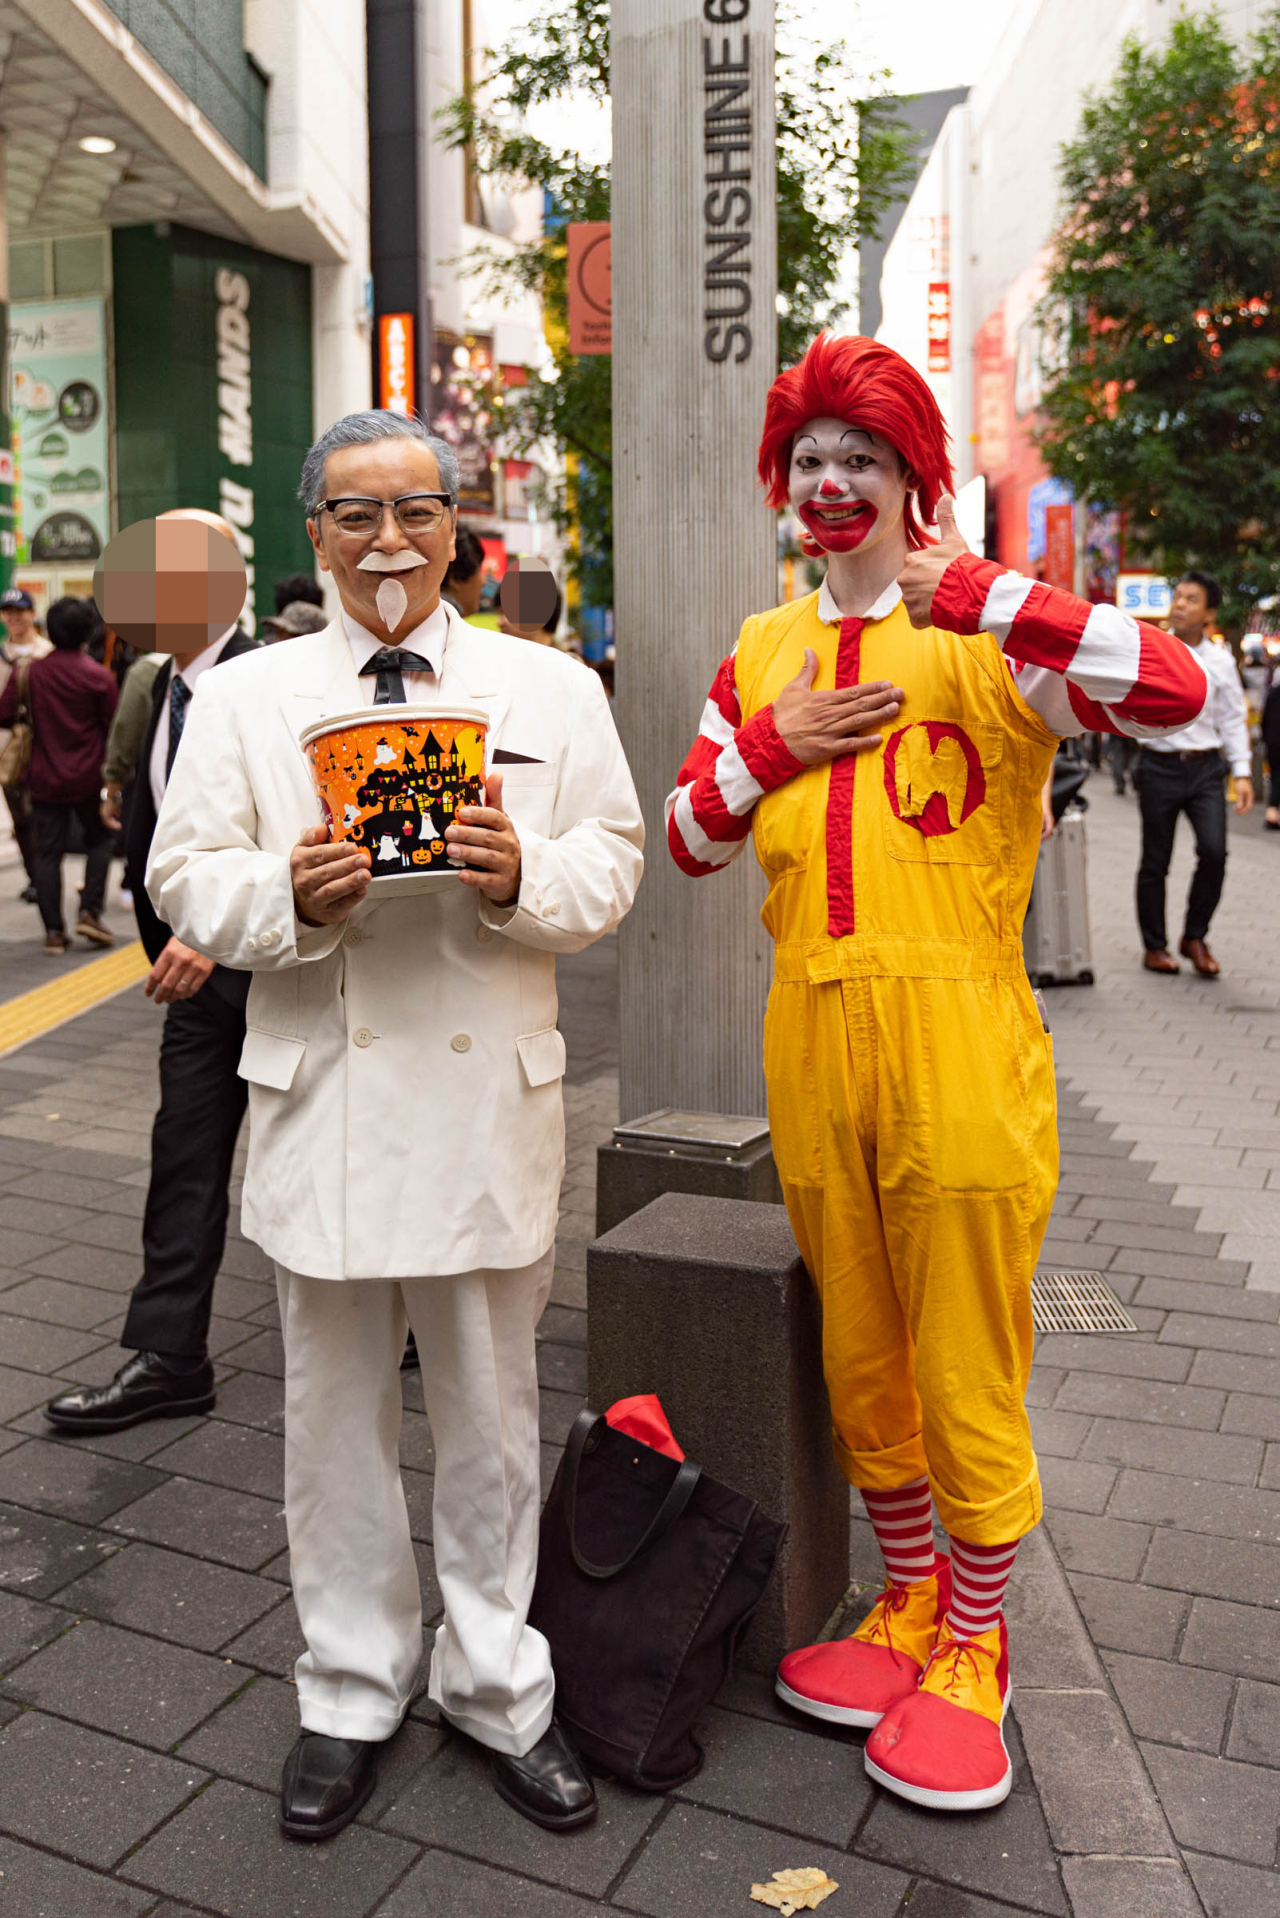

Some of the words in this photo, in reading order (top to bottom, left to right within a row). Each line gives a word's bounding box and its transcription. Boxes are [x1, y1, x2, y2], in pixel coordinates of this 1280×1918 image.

[703, 34, 752, 364] SUNSHINE
[215, 267, 253, 466] HANDS
[1125, 585, 1173, 607] SE
